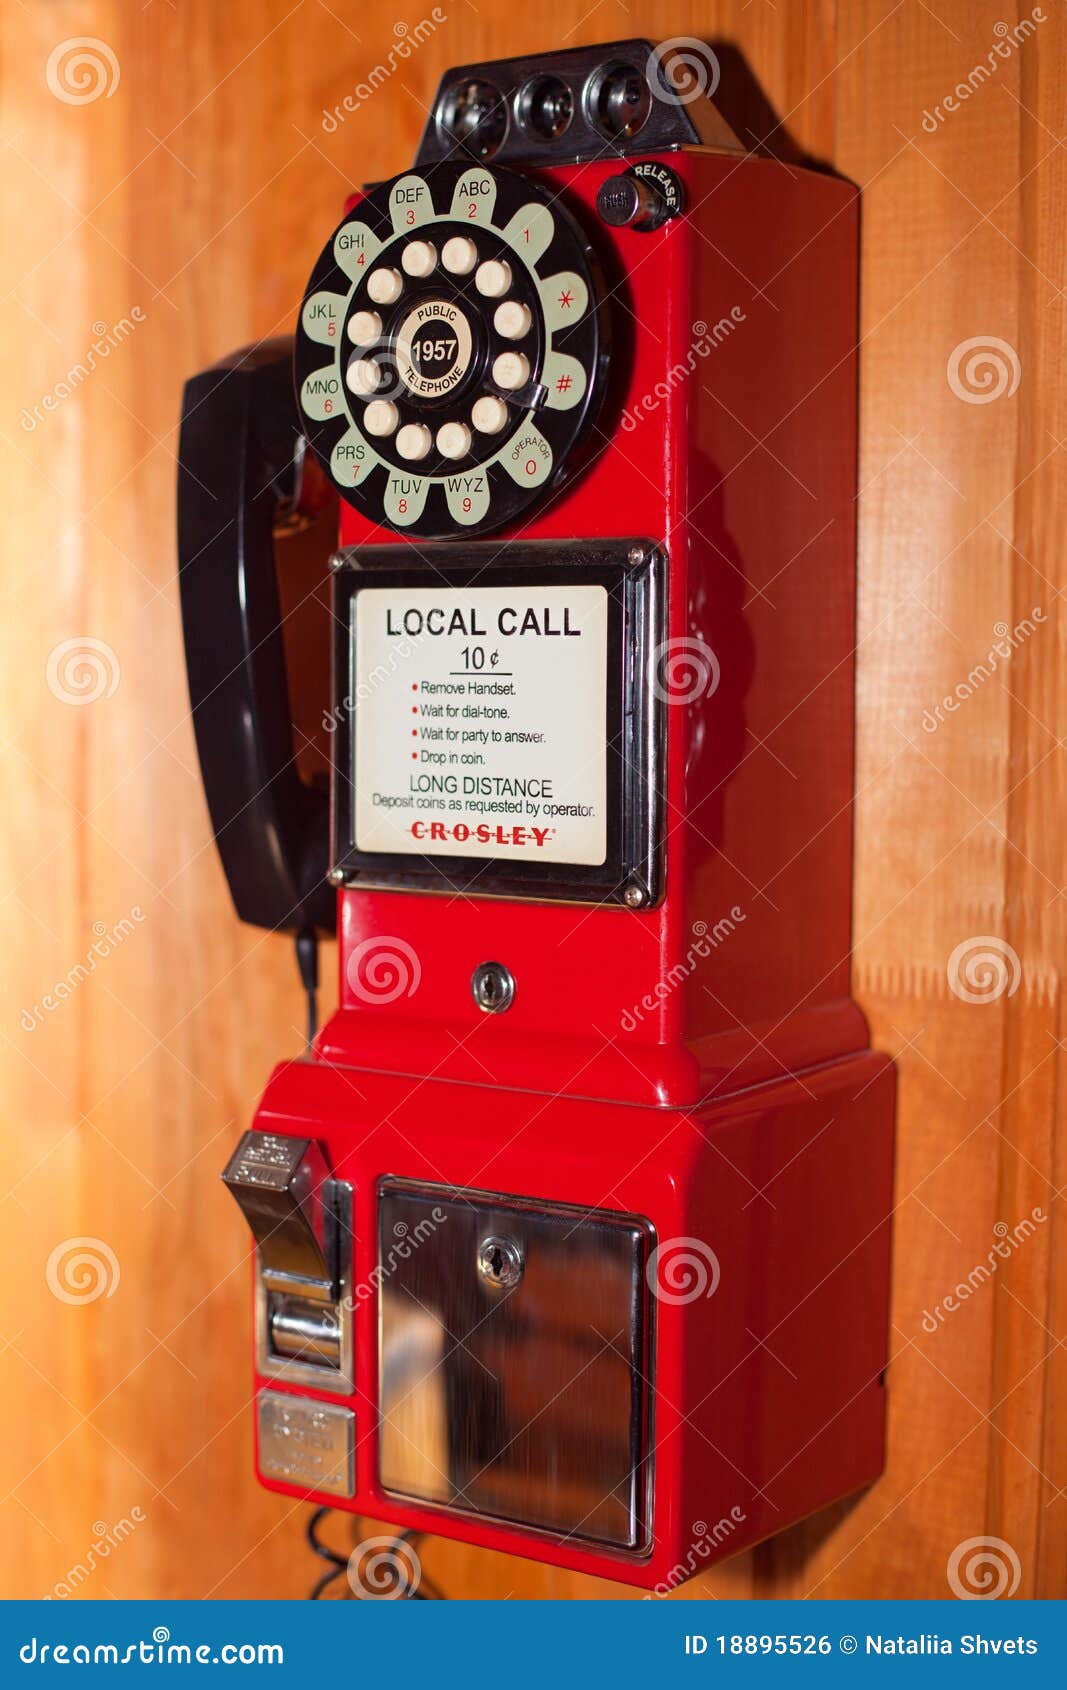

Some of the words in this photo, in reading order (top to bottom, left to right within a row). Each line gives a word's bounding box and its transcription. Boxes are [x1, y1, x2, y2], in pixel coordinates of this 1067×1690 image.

[458, 180, 491, 198] ABC
[634, 164, 676, 207] RELEASE
[395, 187, 424, 203] DEF
[406, 210, 416, 225] 3
[467, 203, 477, 219] 2
[338, 235, 365, 250] GHI
[523, 229, 530, 243] 1
[356, 253, 366, 266] 4
[309, 303, 337, 319] JKL
[417, 305, 457, 321] PUBLIC
[327, 322, 336, 337] 5
[412, 339, 457, 362] 1957
[404, 365, 463, 393] TELEPHONE
[556, 374, 573, 393] #
[306, 380, 339, 395] MNO
[324, 399, 333, 413] 6
[336, 445, 366, 461] PRS
[511, 436, 551, 462] OPERATOR
[351, 465, 361, 479] 7
[391, 480, 422, 495] TUV
[448, 478, 484, 494] WYZ
[398, 498, 408, 514] 8
[462, 498, 473, 513] 9
[386, 608, 487, 637] LOCAL
[497, 607, 581, 637] CALL
[420, 680, 465, 696] Remove
[467, 681, 517, 696] Handset.
[420, 704, 444, 719] Wait
[446, 704, 460, 718] for
[462, 704, 510, 720] dial-tone.
[420, 727, 444, 741] Wait
[446, 727, 460, 741] for
[462, 728, 488, 744] party
[491, 729, 502, 742] to
[504, 731, 547, 744] answer.
[420, 750, 447, 765] Drop
[449, 751, 459, 764] in
[460, 752, 486, 766] coin.
[410, 774, 458, 795] LONG
[463, 777, 554, 799] DISTANCE
[372, 793, 414, 809] Deposit
[416, 796, 446, 811] coins
[448, 801, 463, 812] as
[465, 799, 523, 815] requested
[525, 801, 540, 818] by
[542, 803, 596, 818] operator.
[410, 821, 553, 848] CROSLEY
